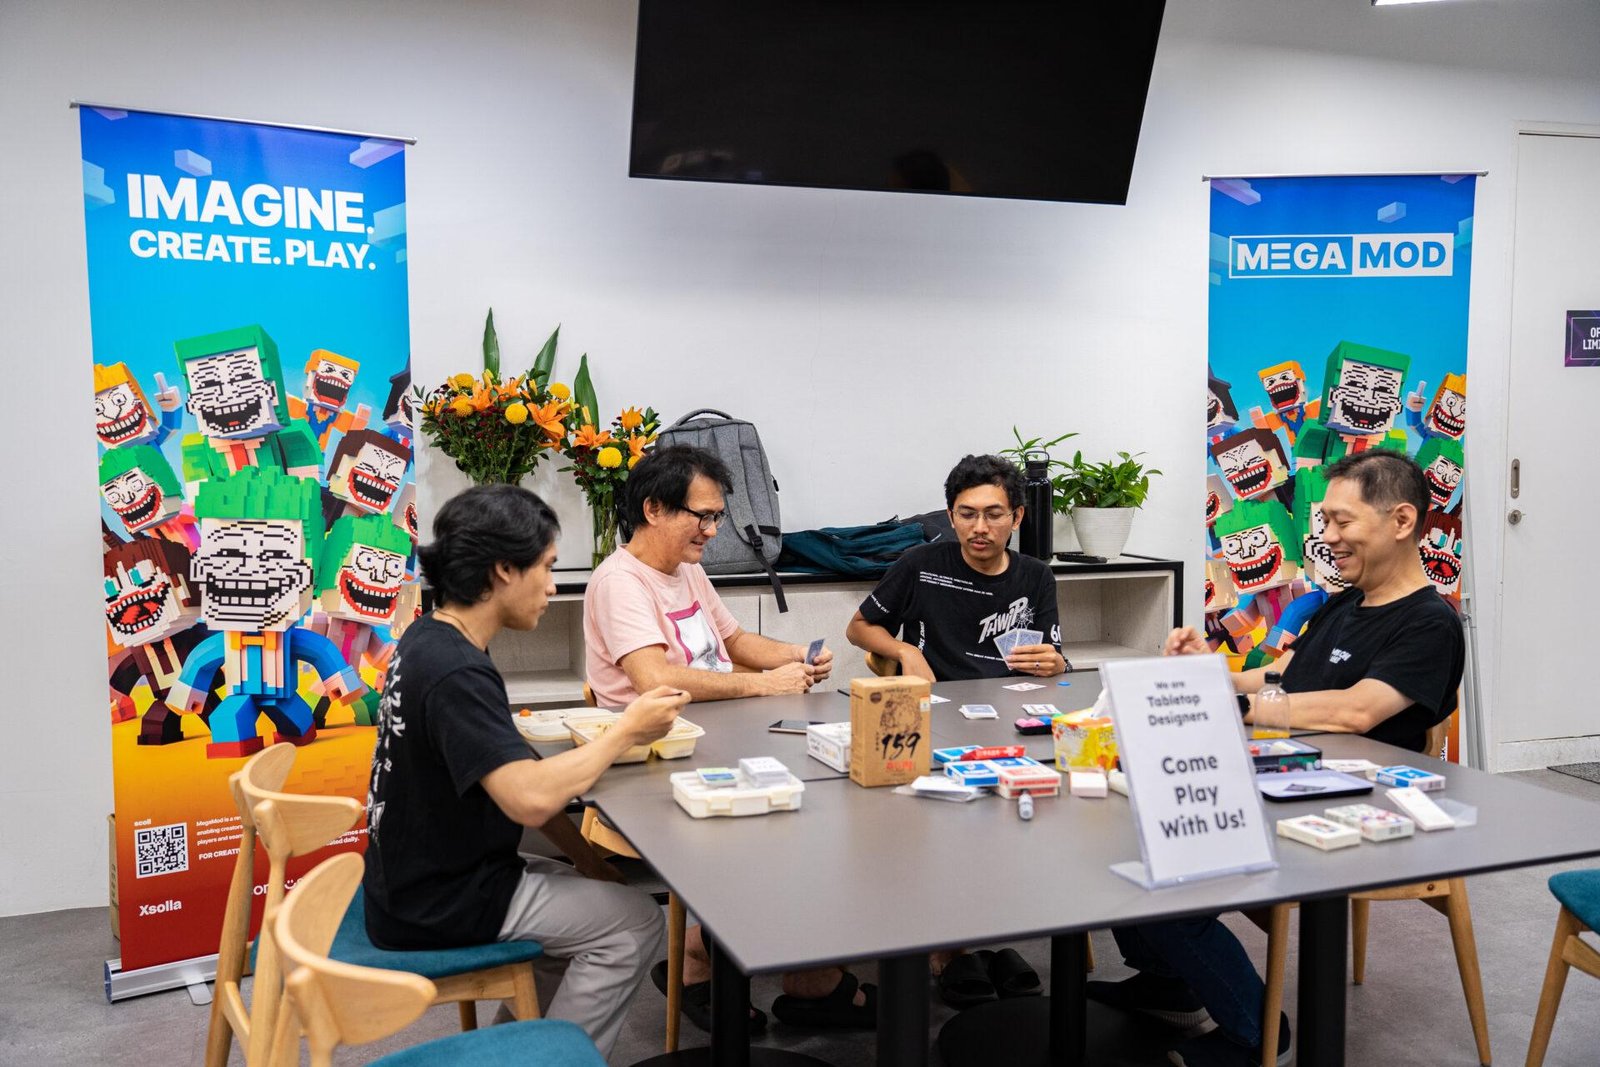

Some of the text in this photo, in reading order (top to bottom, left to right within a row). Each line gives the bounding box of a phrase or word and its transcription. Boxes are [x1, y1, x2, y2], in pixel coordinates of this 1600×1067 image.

[126, 172, 374, 235] IMAGINE.
[129, 229, 376, 271] CREATE. PLAY.
[1236, 240, 1446, 271] MEGA MOD
[1154, 681, 1185, 689] We are
[1146, 693, 1201, 708] Tabletop
[1148, 710, 1209, 727] Designers
[881, 732, 922, 760] 159
[1161, 755, 1219, 775] Come
[1174, 784, 1219, 806] Play
[1159, 809, 1246, 839] With Us!
[198, 851, 213, 861] FOR
[139, 899, 182, 917] Xsolla
